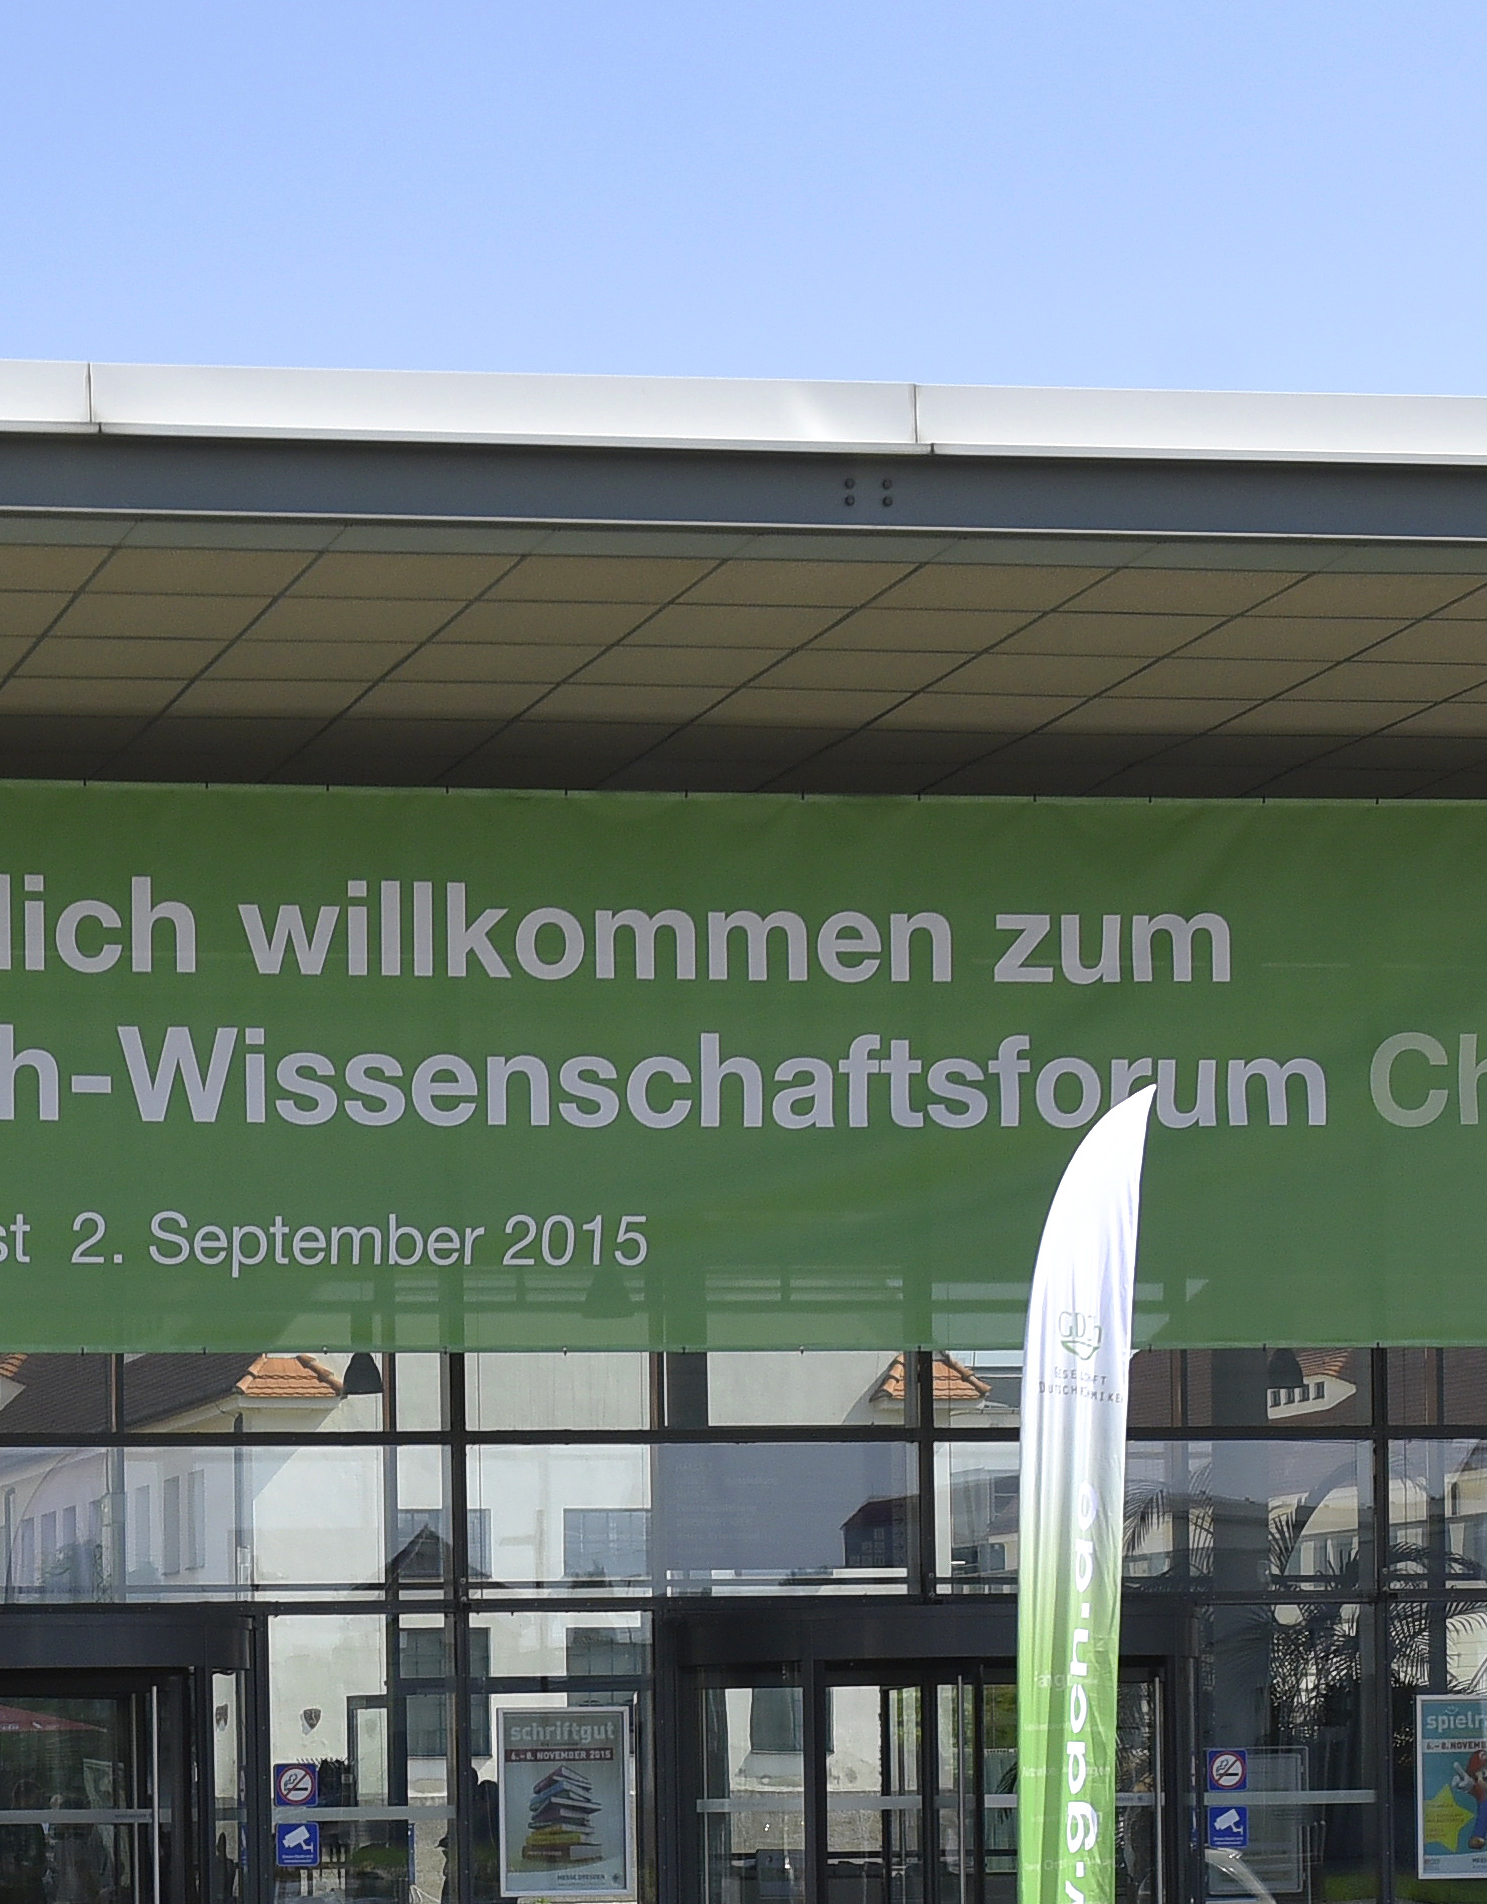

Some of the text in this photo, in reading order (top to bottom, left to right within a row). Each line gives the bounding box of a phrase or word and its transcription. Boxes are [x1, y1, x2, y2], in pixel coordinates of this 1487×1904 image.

[238, 879, 954, 984] willkommen
[993, 912, 1232, 986] zum
[70, 1210, 124, 1264] 2.
[149, 1210, 485, 1278] September
[503, 1213, 649, 1267] 2015
[510, 1720, 614, 1744] schriftgut
[537, 1750, 587, 1761] NOVEMBER
[589, 1750, 611, 1760] 2015
